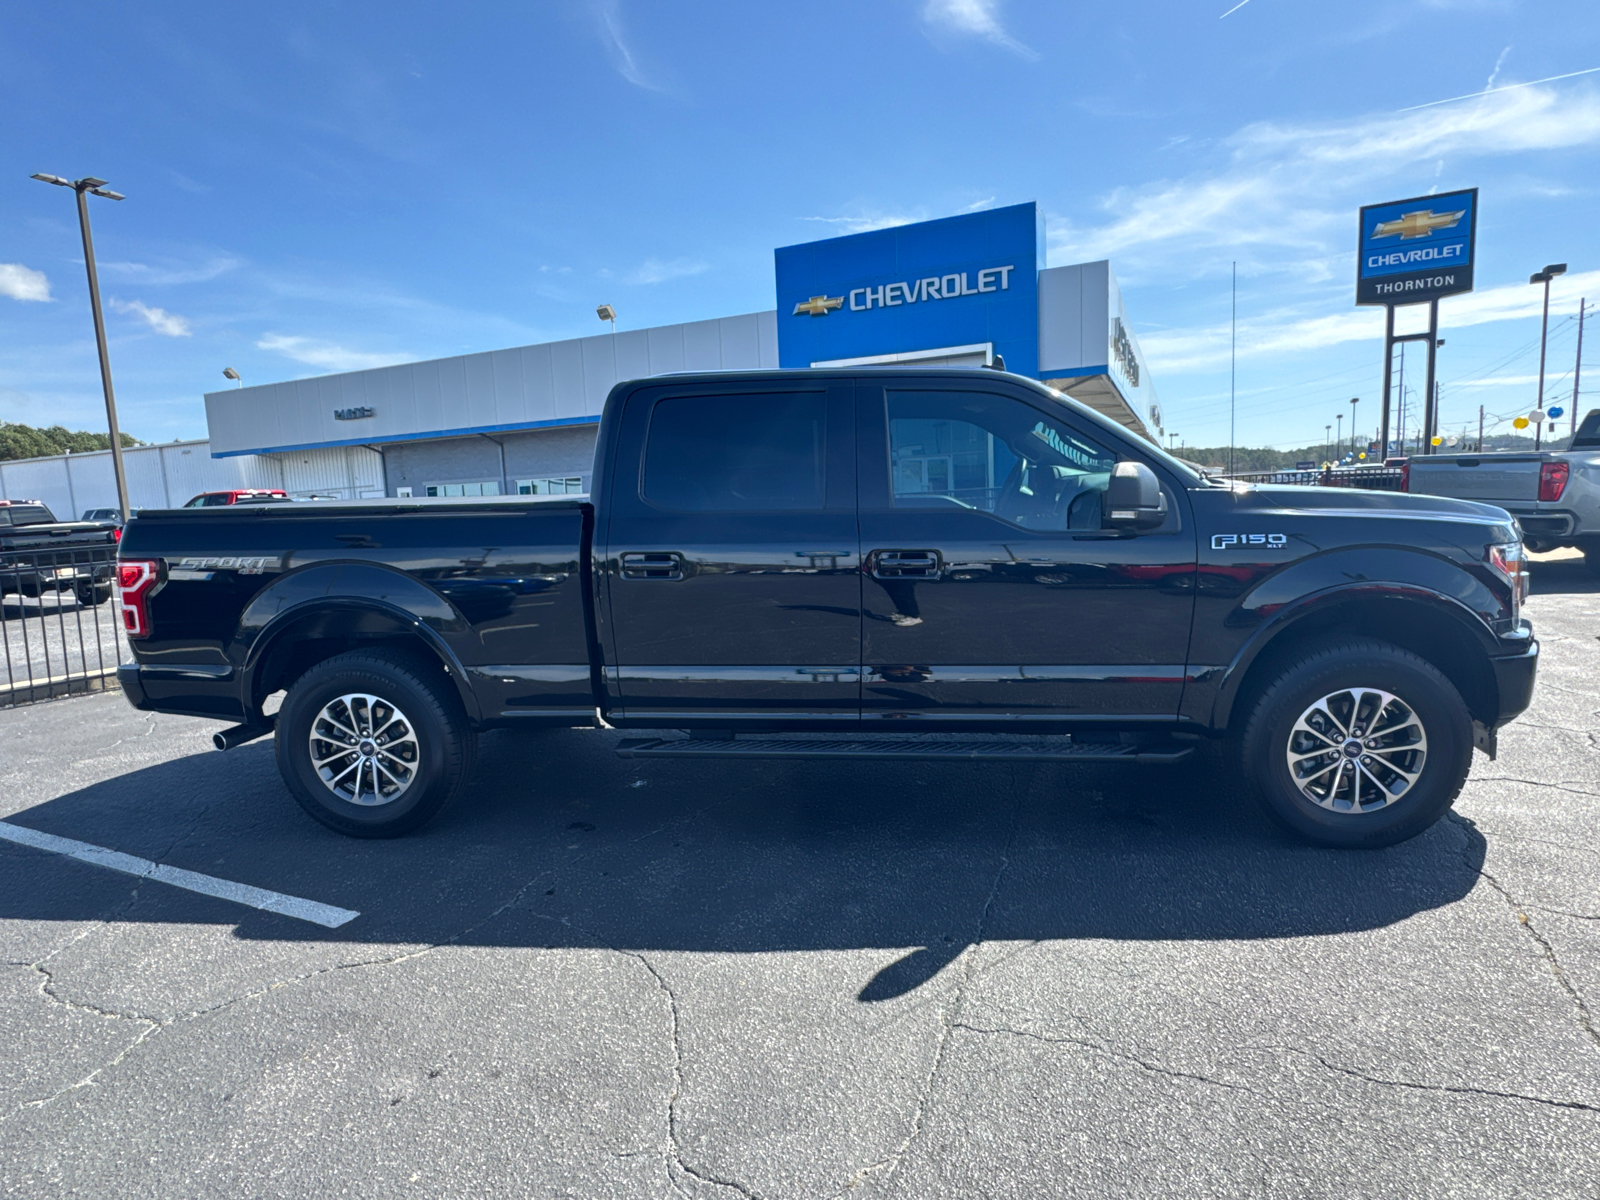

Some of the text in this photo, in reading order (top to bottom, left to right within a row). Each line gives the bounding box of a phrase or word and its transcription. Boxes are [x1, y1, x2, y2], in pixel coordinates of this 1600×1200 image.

[1367, 243, 1464, 268] CHEVROLET
[849, 264, 1015, 312] CHEVROLET
[1375, 274, 1455, 294] THORNTON
[171, 556, 278, 571] SPORT
